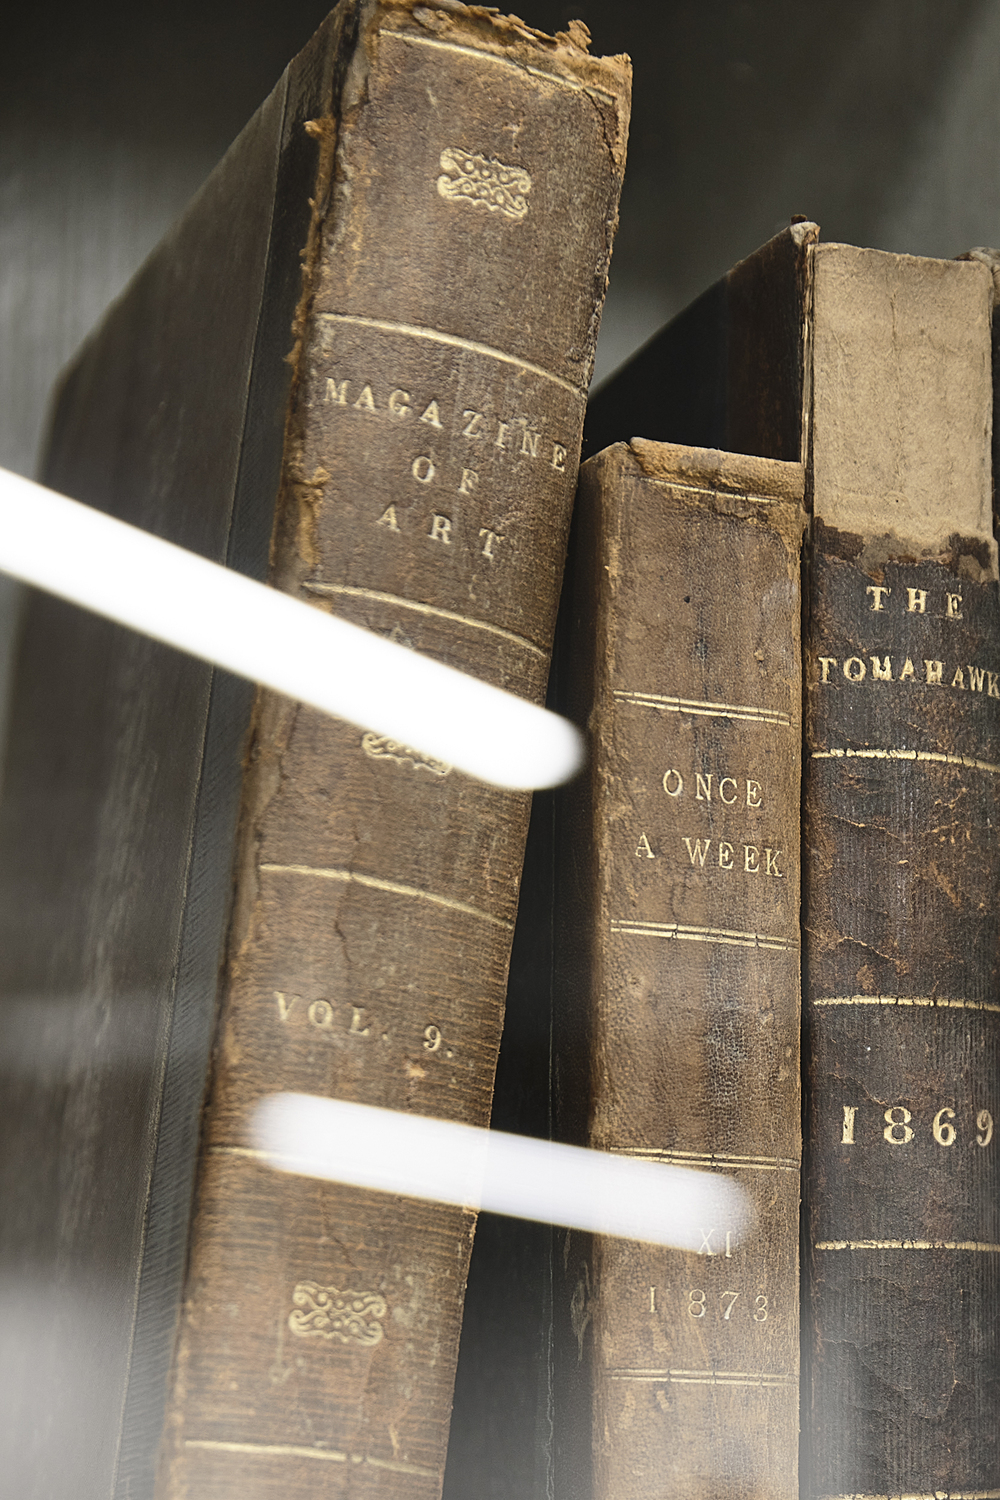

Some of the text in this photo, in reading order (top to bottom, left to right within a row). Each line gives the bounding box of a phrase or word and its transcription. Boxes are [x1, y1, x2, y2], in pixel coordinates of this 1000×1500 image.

[323, 376, 568, 473] MAGAZINE
[411, 455, 480, 495] OF
[375, 503, 506, 561] ART
[865, 584, 964, 622] THE
[818, 654, 1000, 700] TOMAHAWK
[662, 768, 764, 808] ONCE
[634, 831, 784, 878] A WEEK
[840, 1104, 995, 1147] 1869
[649, 1285, 769, 1322] 1873
